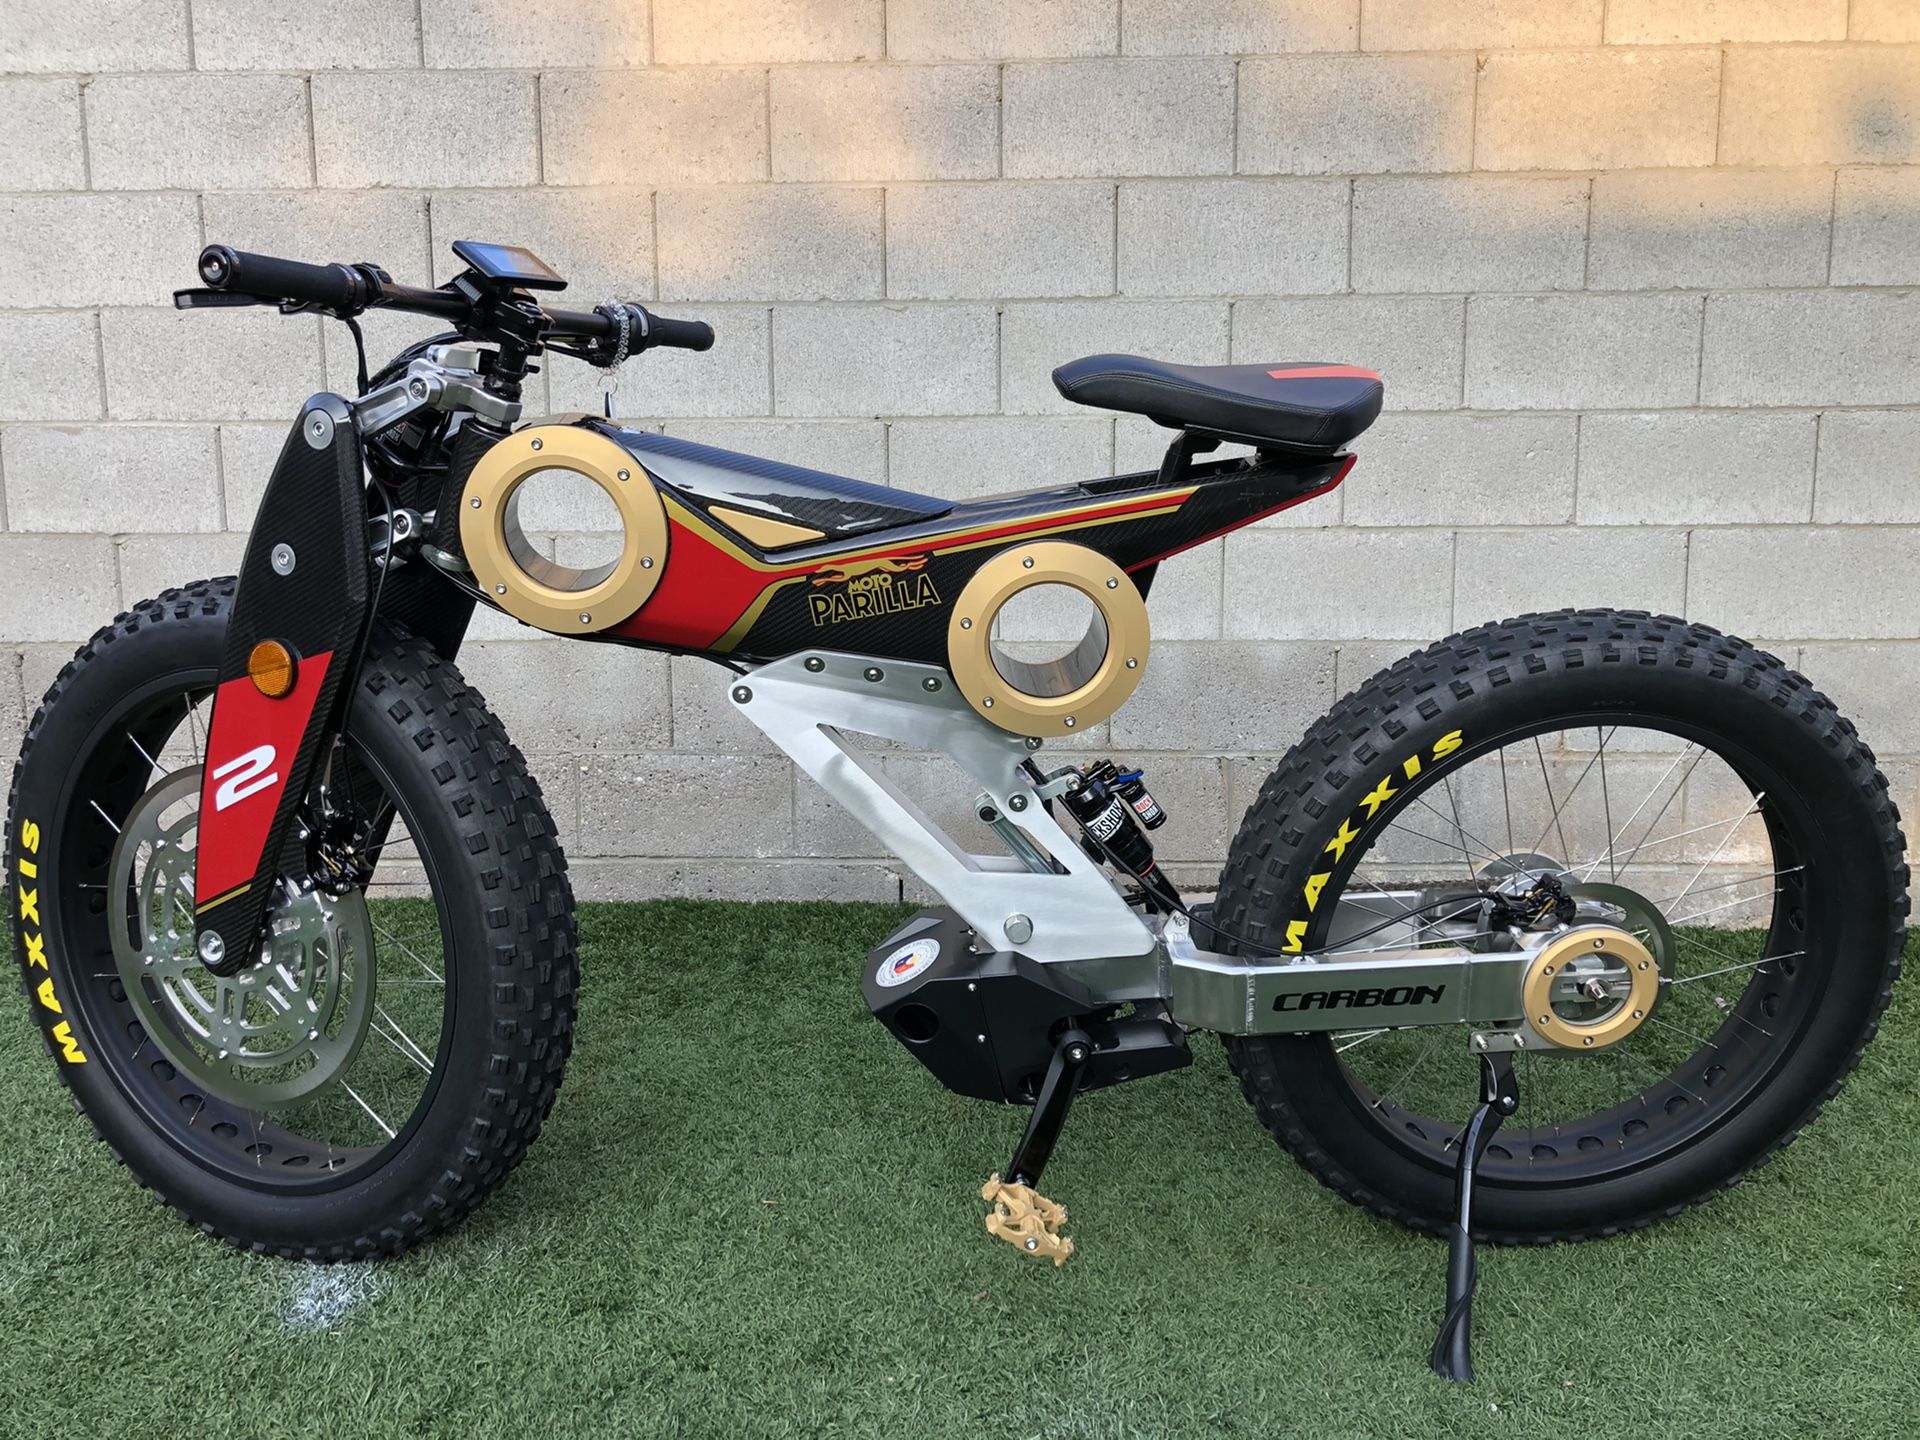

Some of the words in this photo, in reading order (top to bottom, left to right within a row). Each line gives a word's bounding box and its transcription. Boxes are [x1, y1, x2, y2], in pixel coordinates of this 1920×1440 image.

[808, 573, 941, 627] PARILLA
[848, 574, 892, 592] MOTO
[212, 745, 278, 811] 2
[1135, 797, 1153, 812] ROCK
[1281, 730, 1463, 957] MAXXIS
[19, 818, 87, 1063] MAXXIS
[1272, 984, 1446, 1012] CARBON
